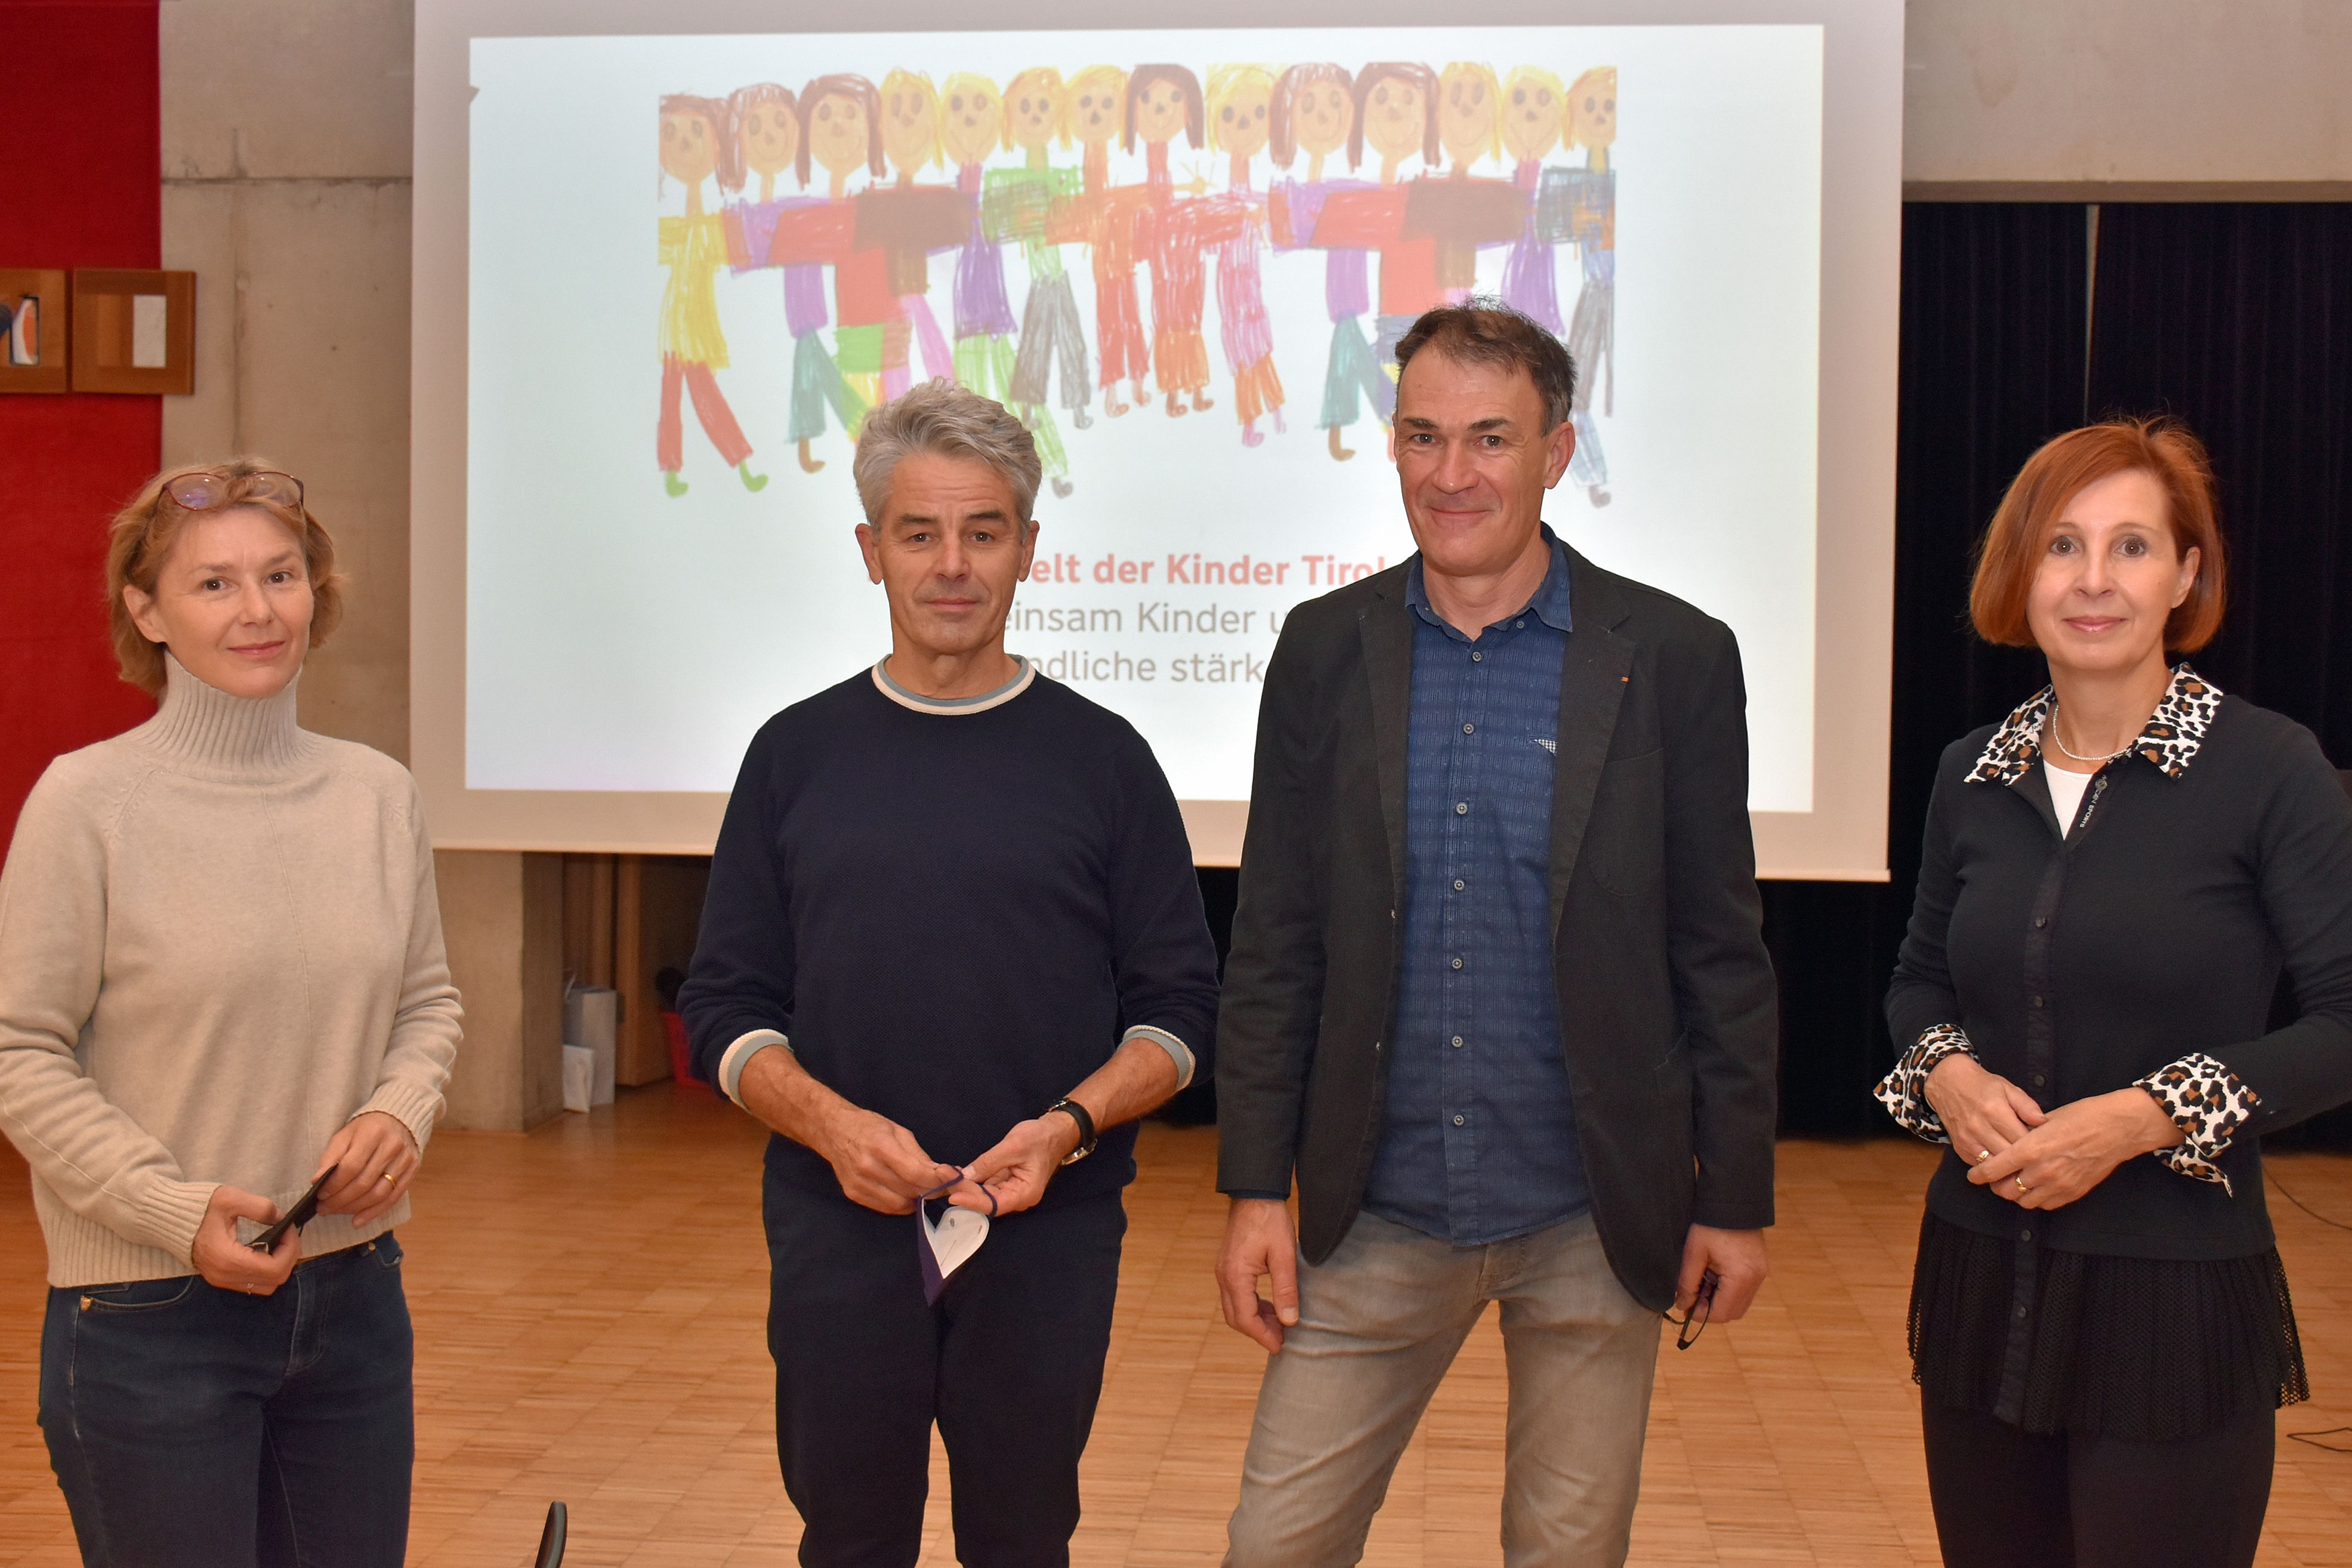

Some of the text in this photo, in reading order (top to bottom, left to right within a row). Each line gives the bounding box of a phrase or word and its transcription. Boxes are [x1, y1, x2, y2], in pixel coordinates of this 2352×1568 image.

[1031, 552, 1081, 583] elt
[1093, 552, 1155, 584] der
[1167, 552, 1291, 585] Kinder
[1138, 601, 1257, 634] Kinder
